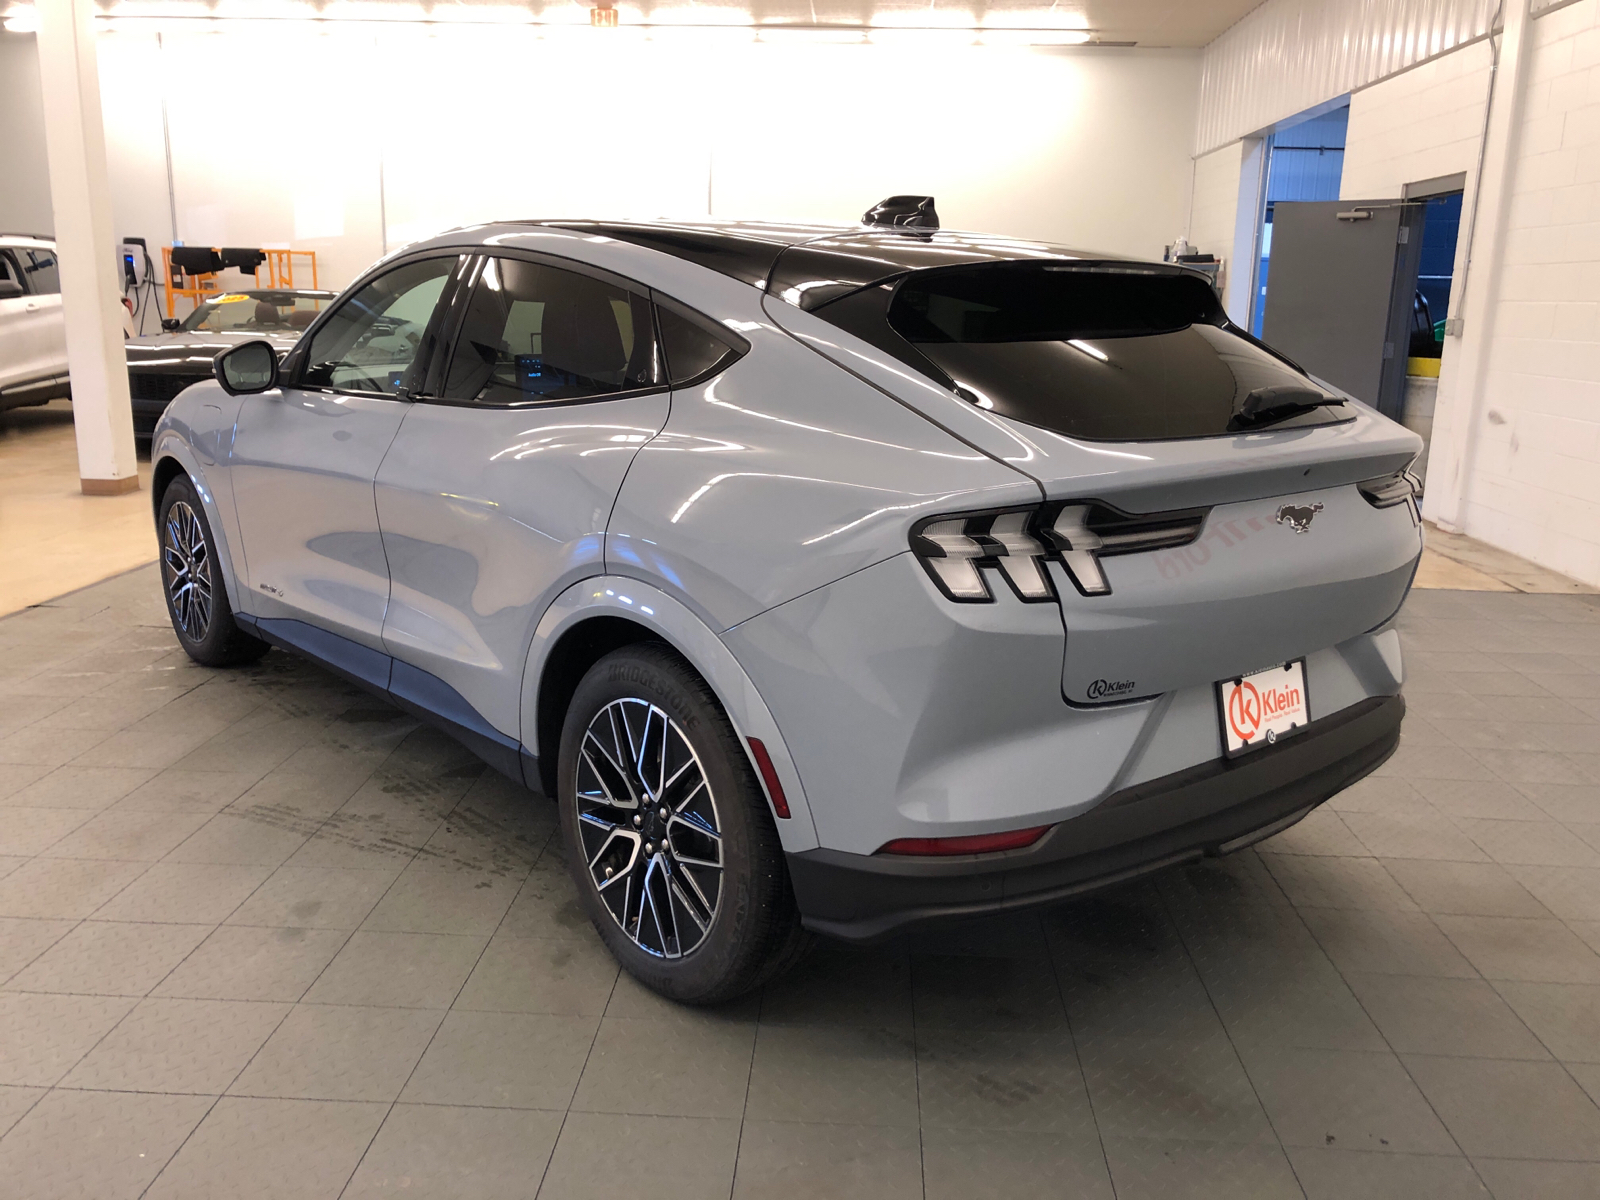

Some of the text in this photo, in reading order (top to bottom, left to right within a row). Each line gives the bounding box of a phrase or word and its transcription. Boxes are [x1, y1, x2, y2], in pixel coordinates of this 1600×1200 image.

[607, 663, 700, 731] BRIDGESTONE
[1107, 680, 1136, 692] Klein
[1261, 684, 1301, 716] Klein
